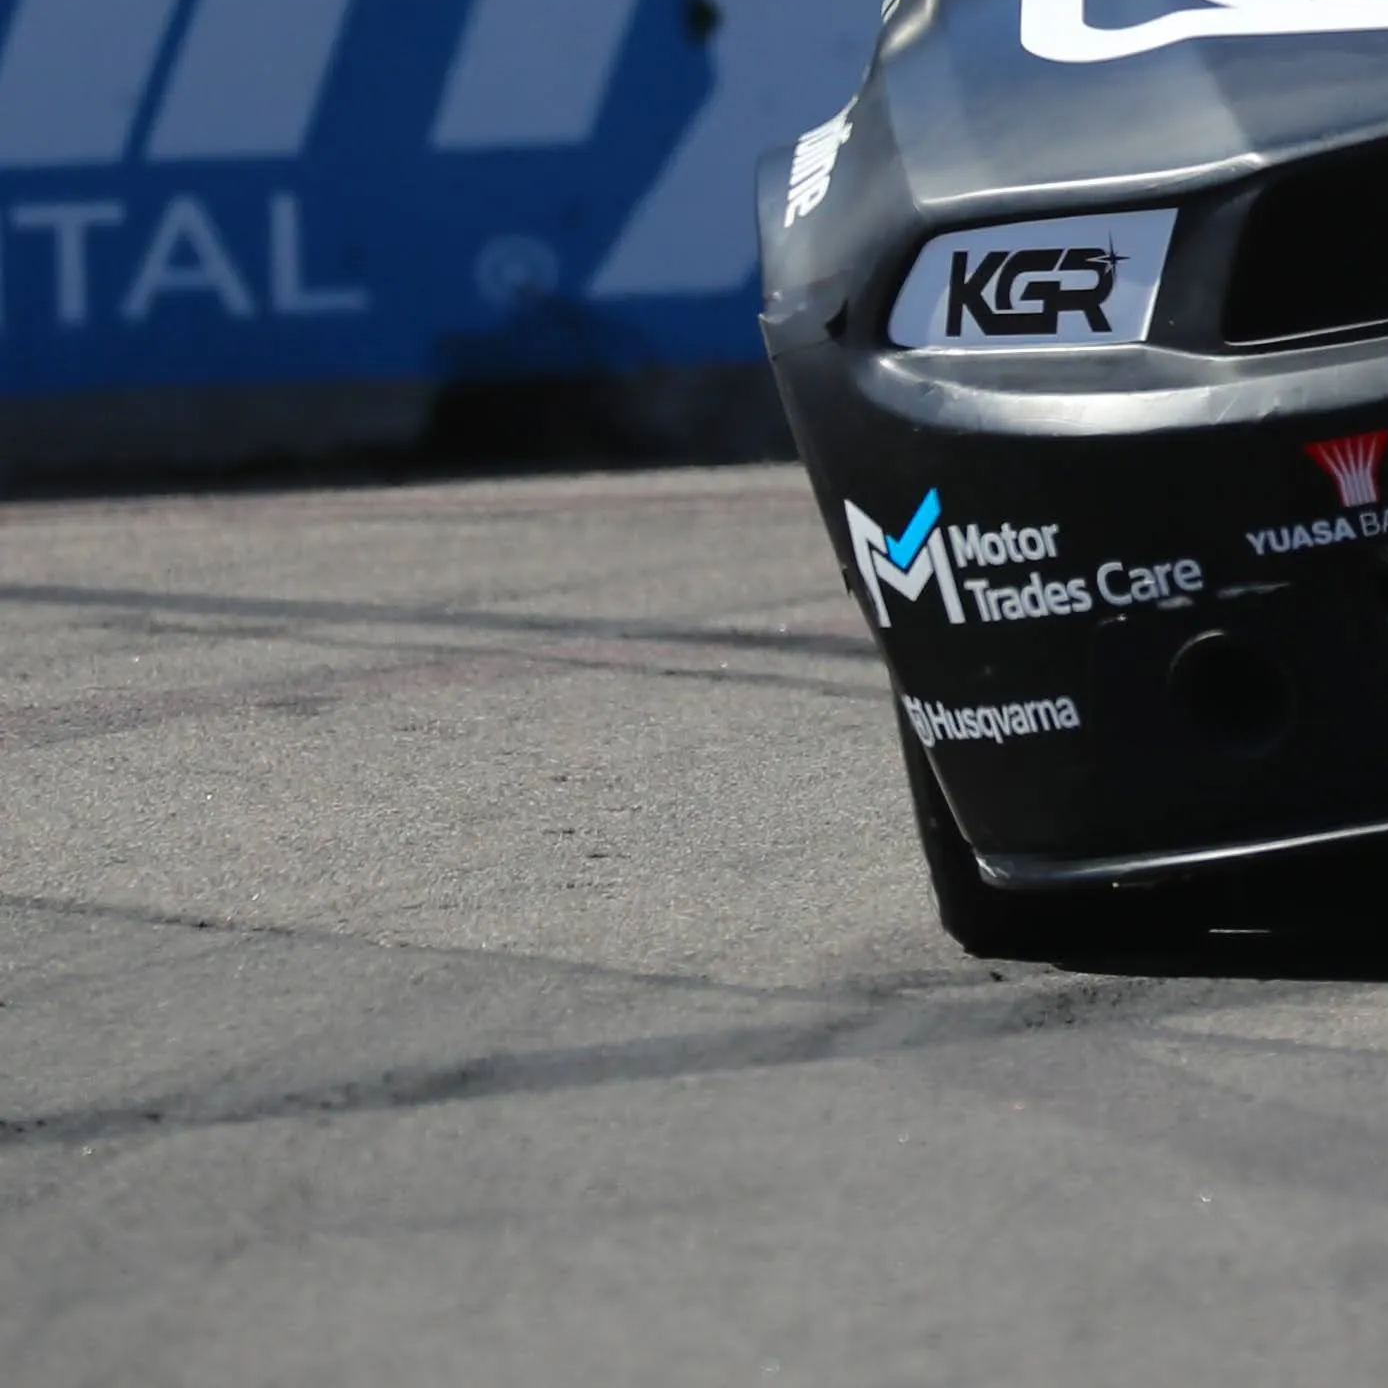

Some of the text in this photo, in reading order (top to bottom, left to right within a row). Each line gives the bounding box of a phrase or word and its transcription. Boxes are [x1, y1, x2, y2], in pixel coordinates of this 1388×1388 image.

[945, 243, 1118, 337] KGR
[949, 520, 1060, 569] Motor
[1246, 517, 1357, 556] YUASA
[964, 555, 1204, 624] Trades Care
[924, 695, 1082, 745] Husqvarna
